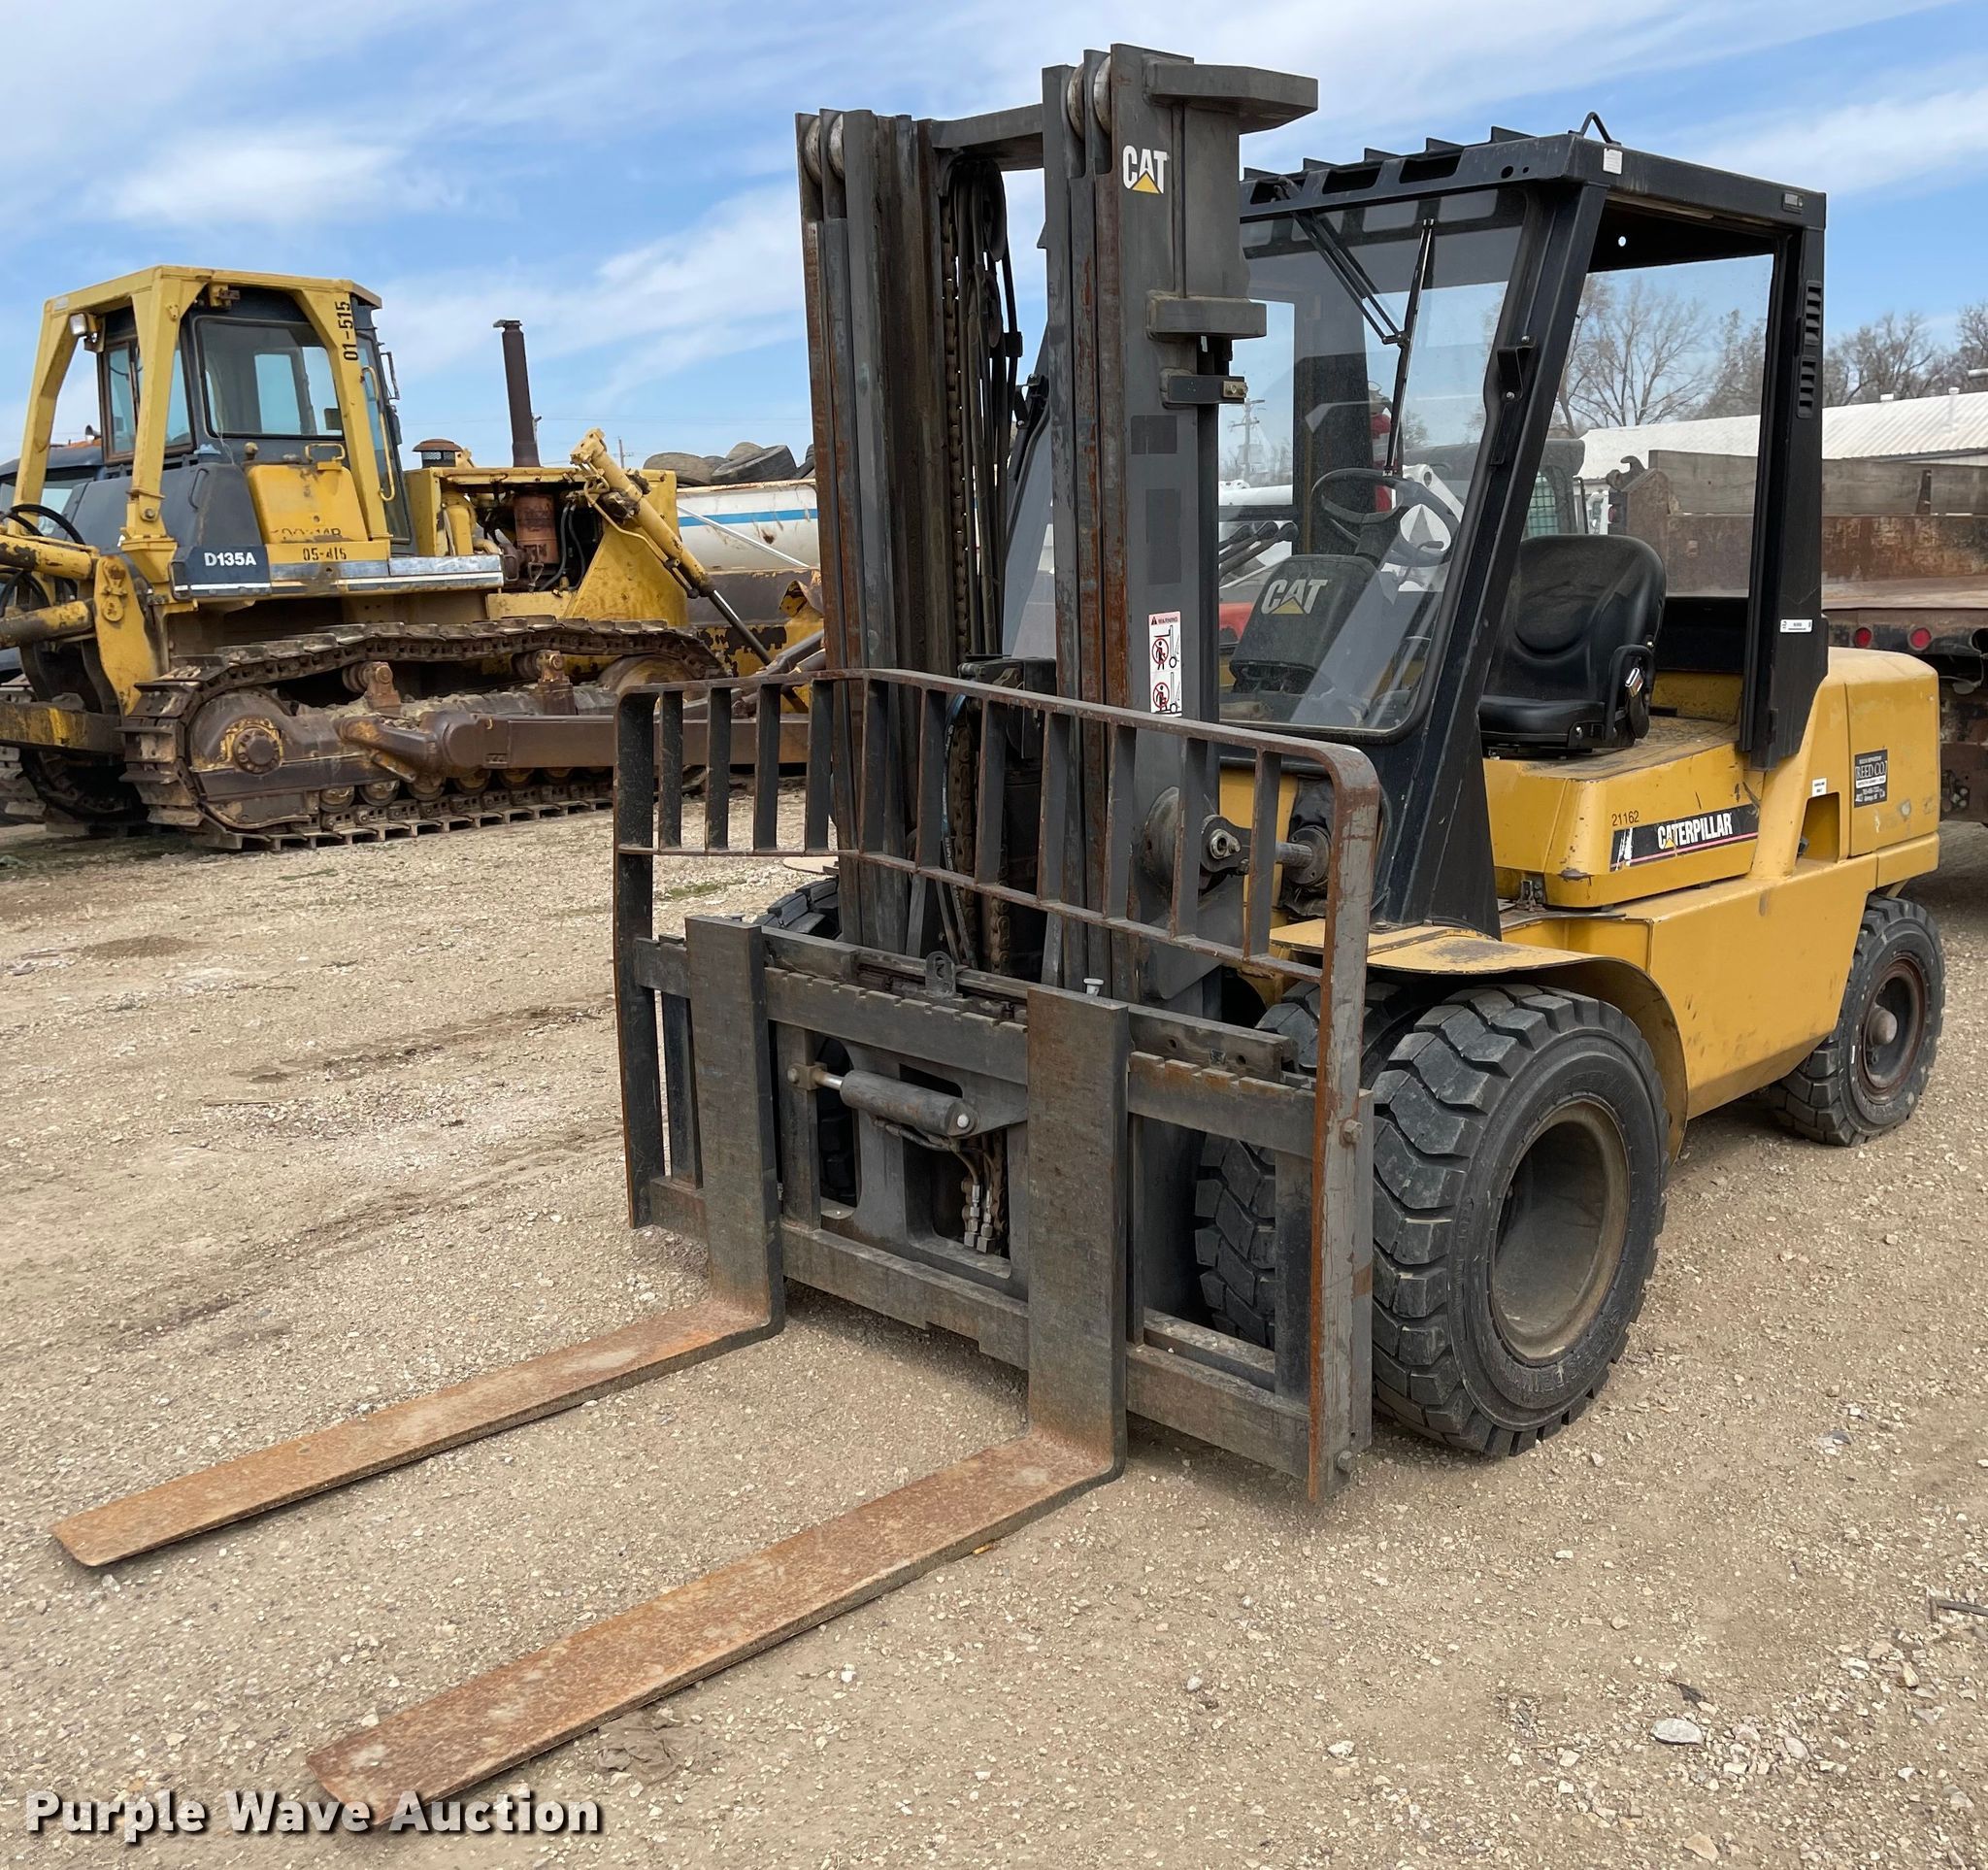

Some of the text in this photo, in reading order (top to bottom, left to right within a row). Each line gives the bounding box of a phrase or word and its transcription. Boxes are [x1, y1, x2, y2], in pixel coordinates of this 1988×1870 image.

[1123, 145, 1168, 194] CAT
[334, 301, 358, 361] 01-515
[204, 551, 257, 567] D135A
[1261, 579, 1329, 615] CAT
[1611, 810, 1640, 826] 21162
[1657, 813, 1734, 850] CATERPILLAR
